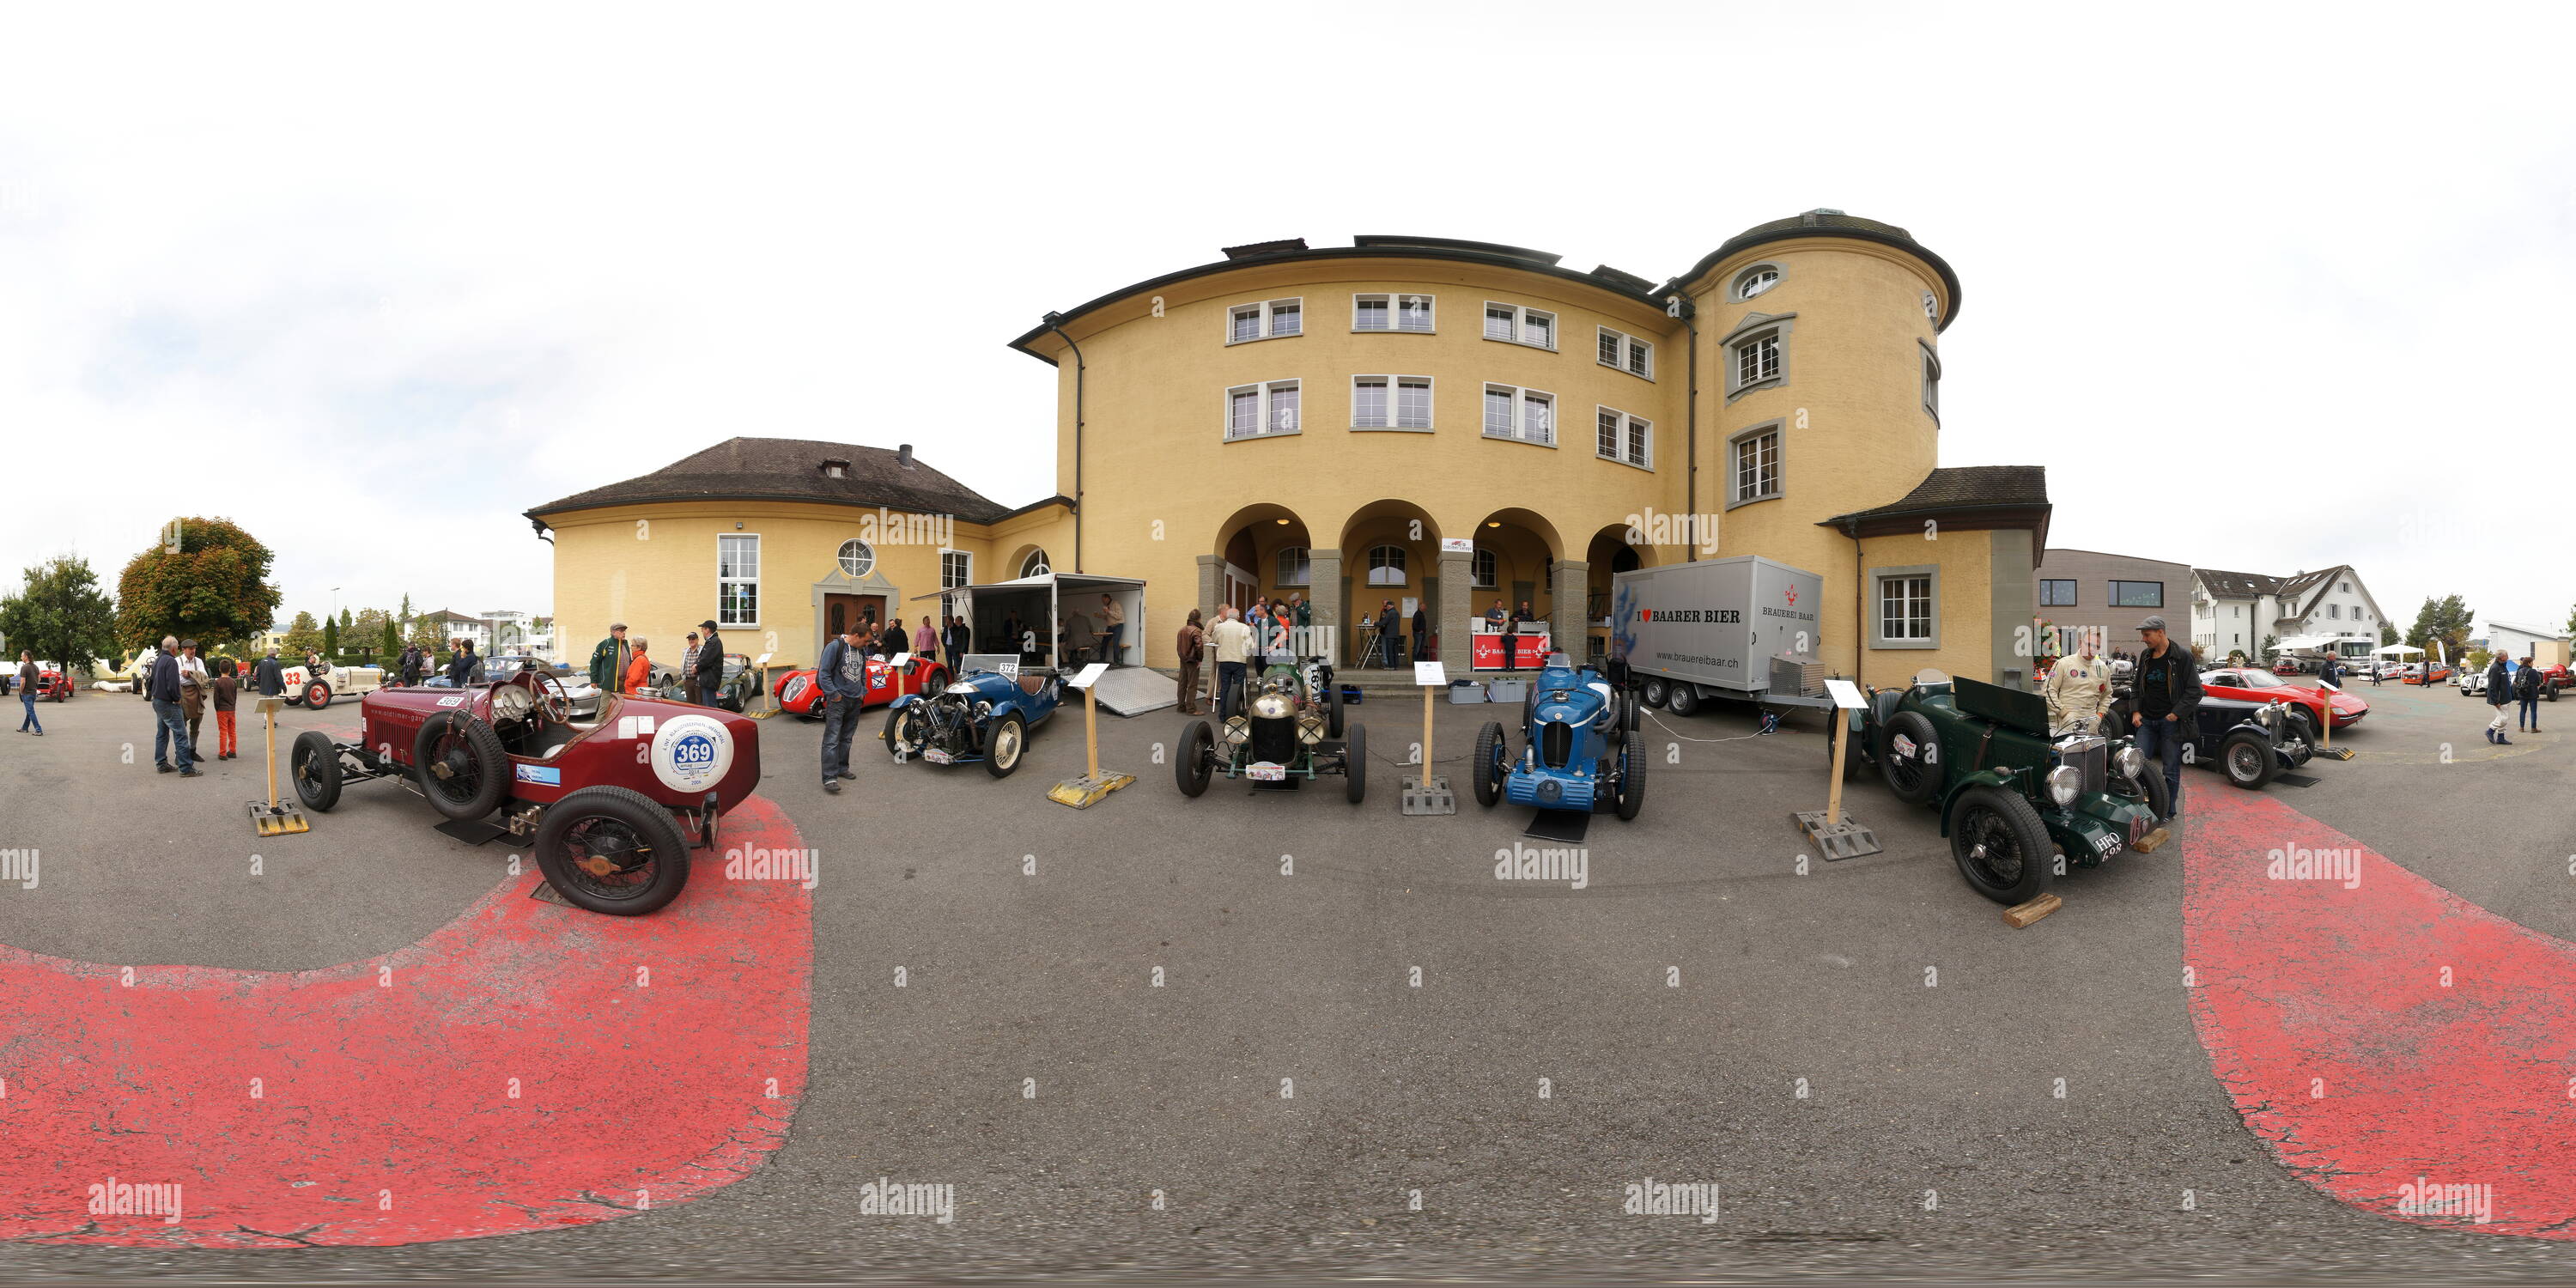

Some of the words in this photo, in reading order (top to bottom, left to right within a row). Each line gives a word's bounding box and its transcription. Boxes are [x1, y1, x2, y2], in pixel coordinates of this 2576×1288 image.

[1637, 611, 1641, 621] I
[1652, 610, 1701, 623] BAARER
[1704, 610, 1741, 623] BIER
[1762, 607, 1796, 618] BRAUEREI
[1799, 612, 1814, 621] BAAR
[1656, 651, 1739, 669] www.brauereibaar.ch
[1000, 664, 1016, 672] 372
[285, 672, 301, 685] 33
[439, 696, 461, 706] 369
[677, 743, 711, 762] 369
[2095, 832, 2120, 851] HFO
[2101, 843, 2122, 862] 698
